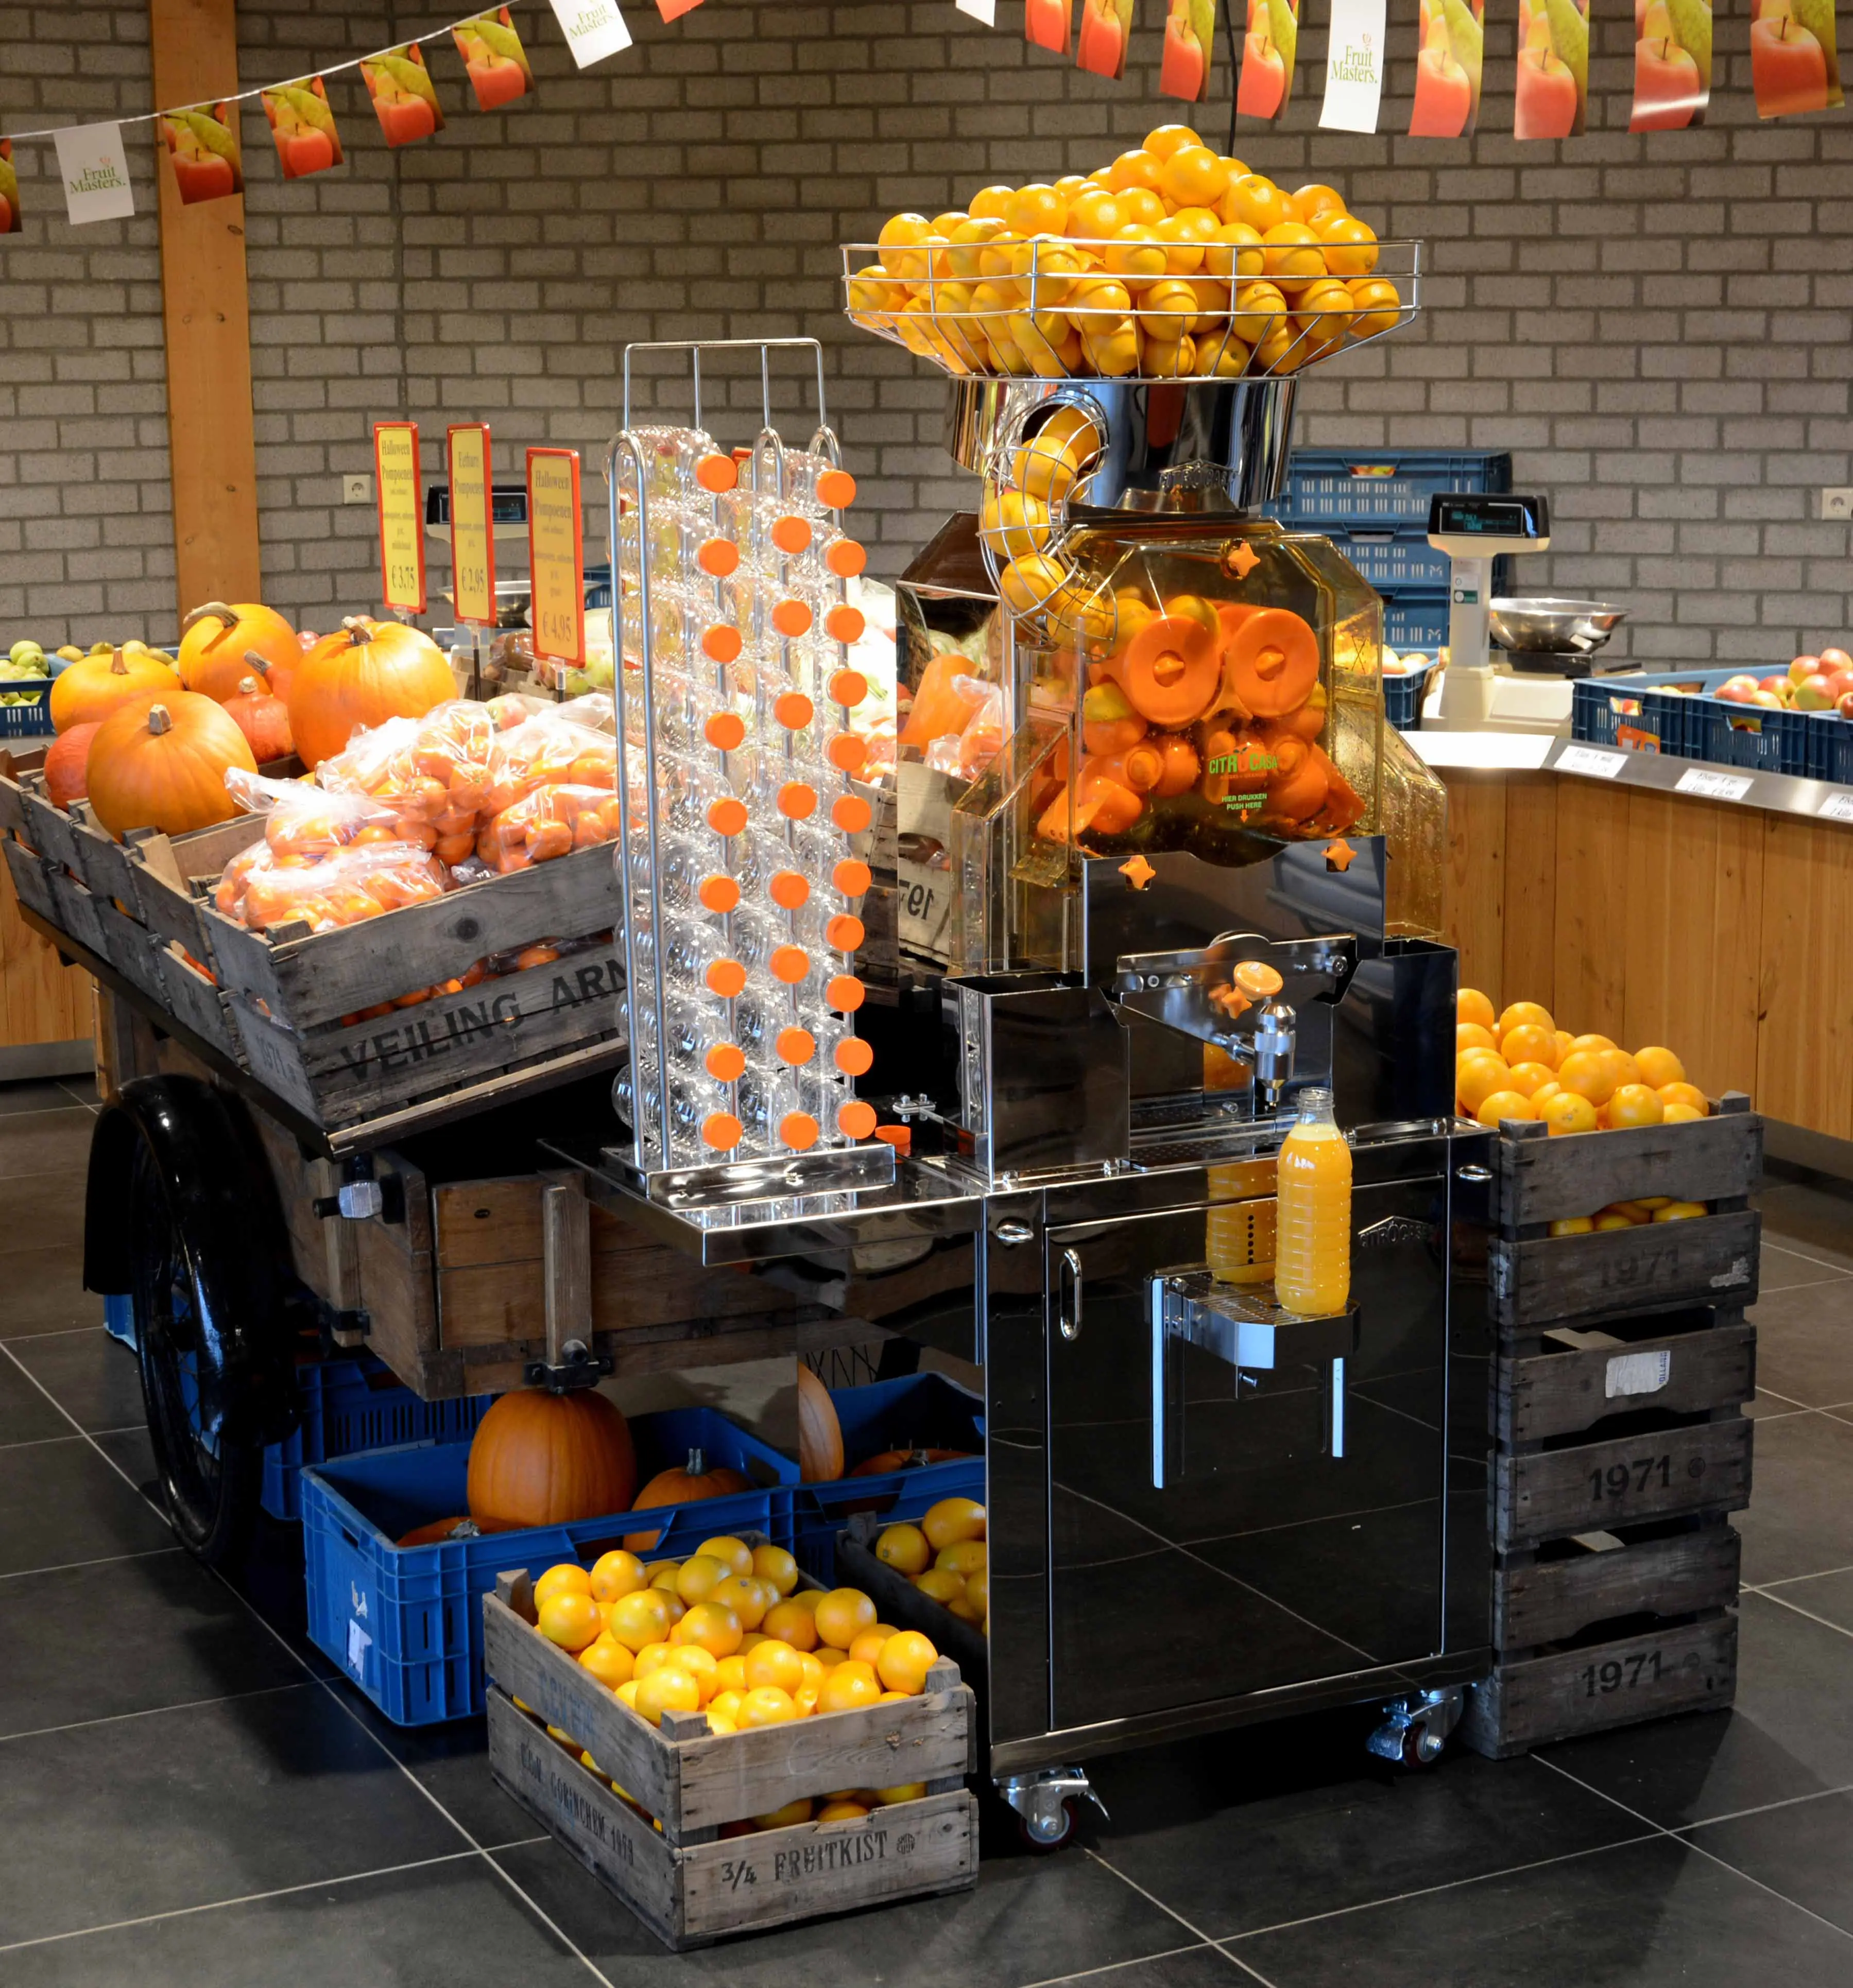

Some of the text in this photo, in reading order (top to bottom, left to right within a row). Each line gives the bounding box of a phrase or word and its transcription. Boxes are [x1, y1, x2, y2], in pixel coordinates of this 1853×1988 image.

[578, 4, 606, 24] Fruit
[1345, 45, 1372, 66] Fruit
[1331, 60, 1377, 83] Masters.
[83, 166, 115, 180] Fruit
[70, 177, 126, 194] Masters.
[382, 440, 410, 456] Halloween
[536, 470, 569, 490] Halloween
[535, 498, 572, 522] Pompoenen
[1238, 793, 1267, 801] DRUKKEN
[339, 992, 524, 1081] VEILING
[1597, 1246, 1679, 1288] 1971
[1659, 1352, 1668, 1385] OLLAND
[1589, 1455, 1670, 1501] 1971
[1582, 1651, 1662, 1698] 1971
[722, 1830, 888, 1890] 3/4 FRUITKIST
